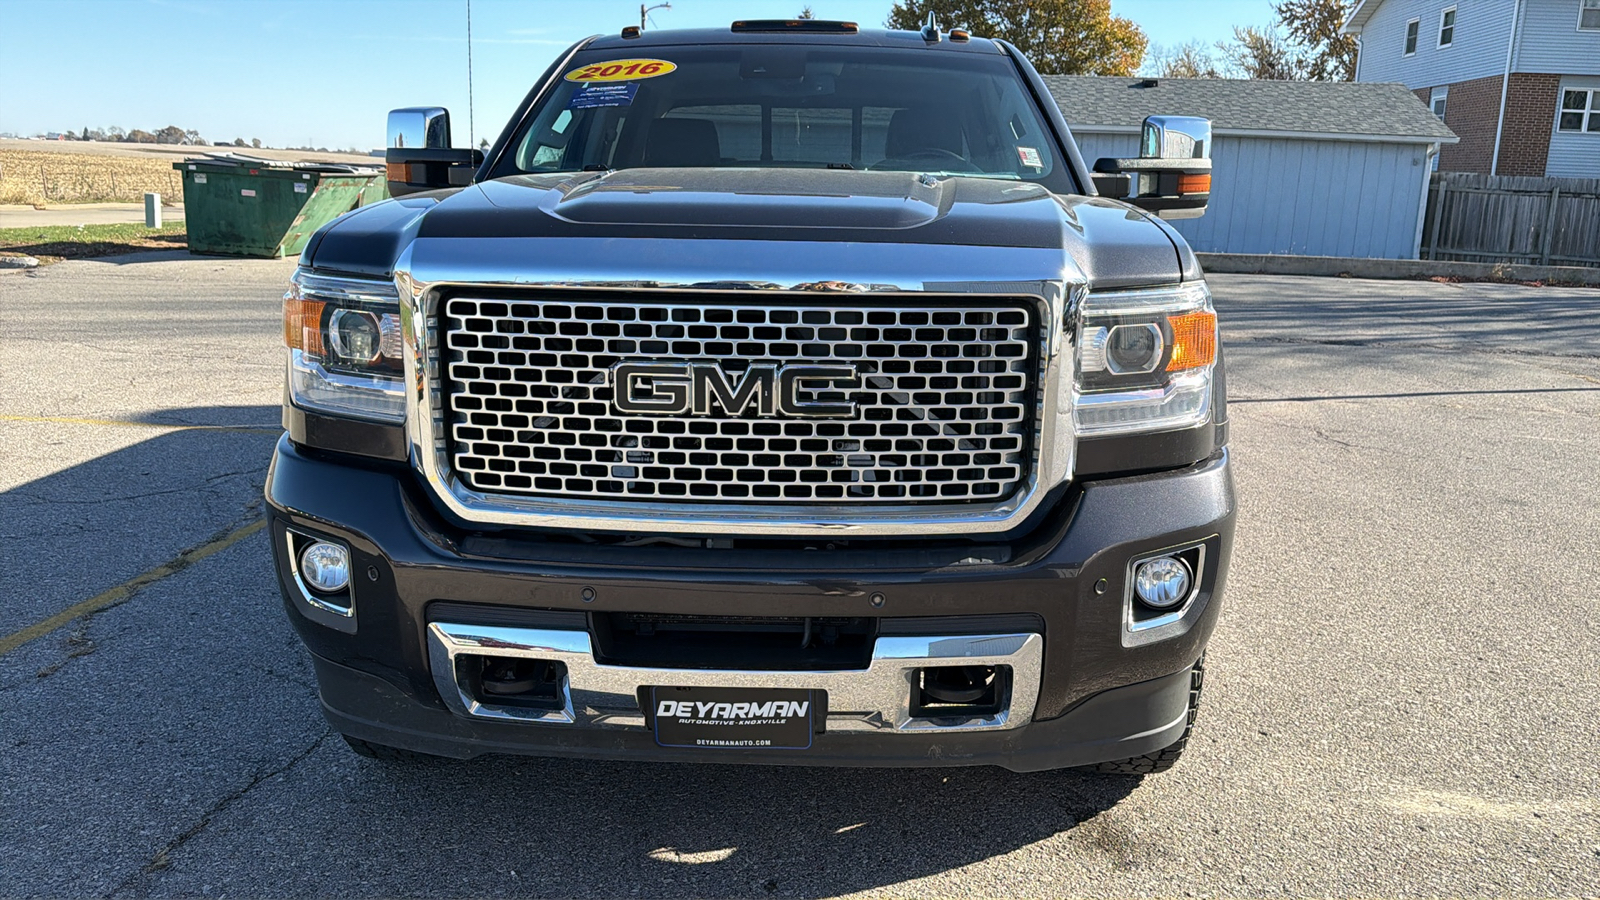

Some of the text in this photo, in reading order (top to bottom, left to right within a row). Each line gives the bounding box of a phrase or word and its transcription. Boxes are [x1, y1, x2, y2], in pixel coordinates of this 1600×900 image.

[575, 63, 663, 79] 2016
[612, 360, 858, 417] GMC
[656, 700, 809, 718] DEYARMAN
